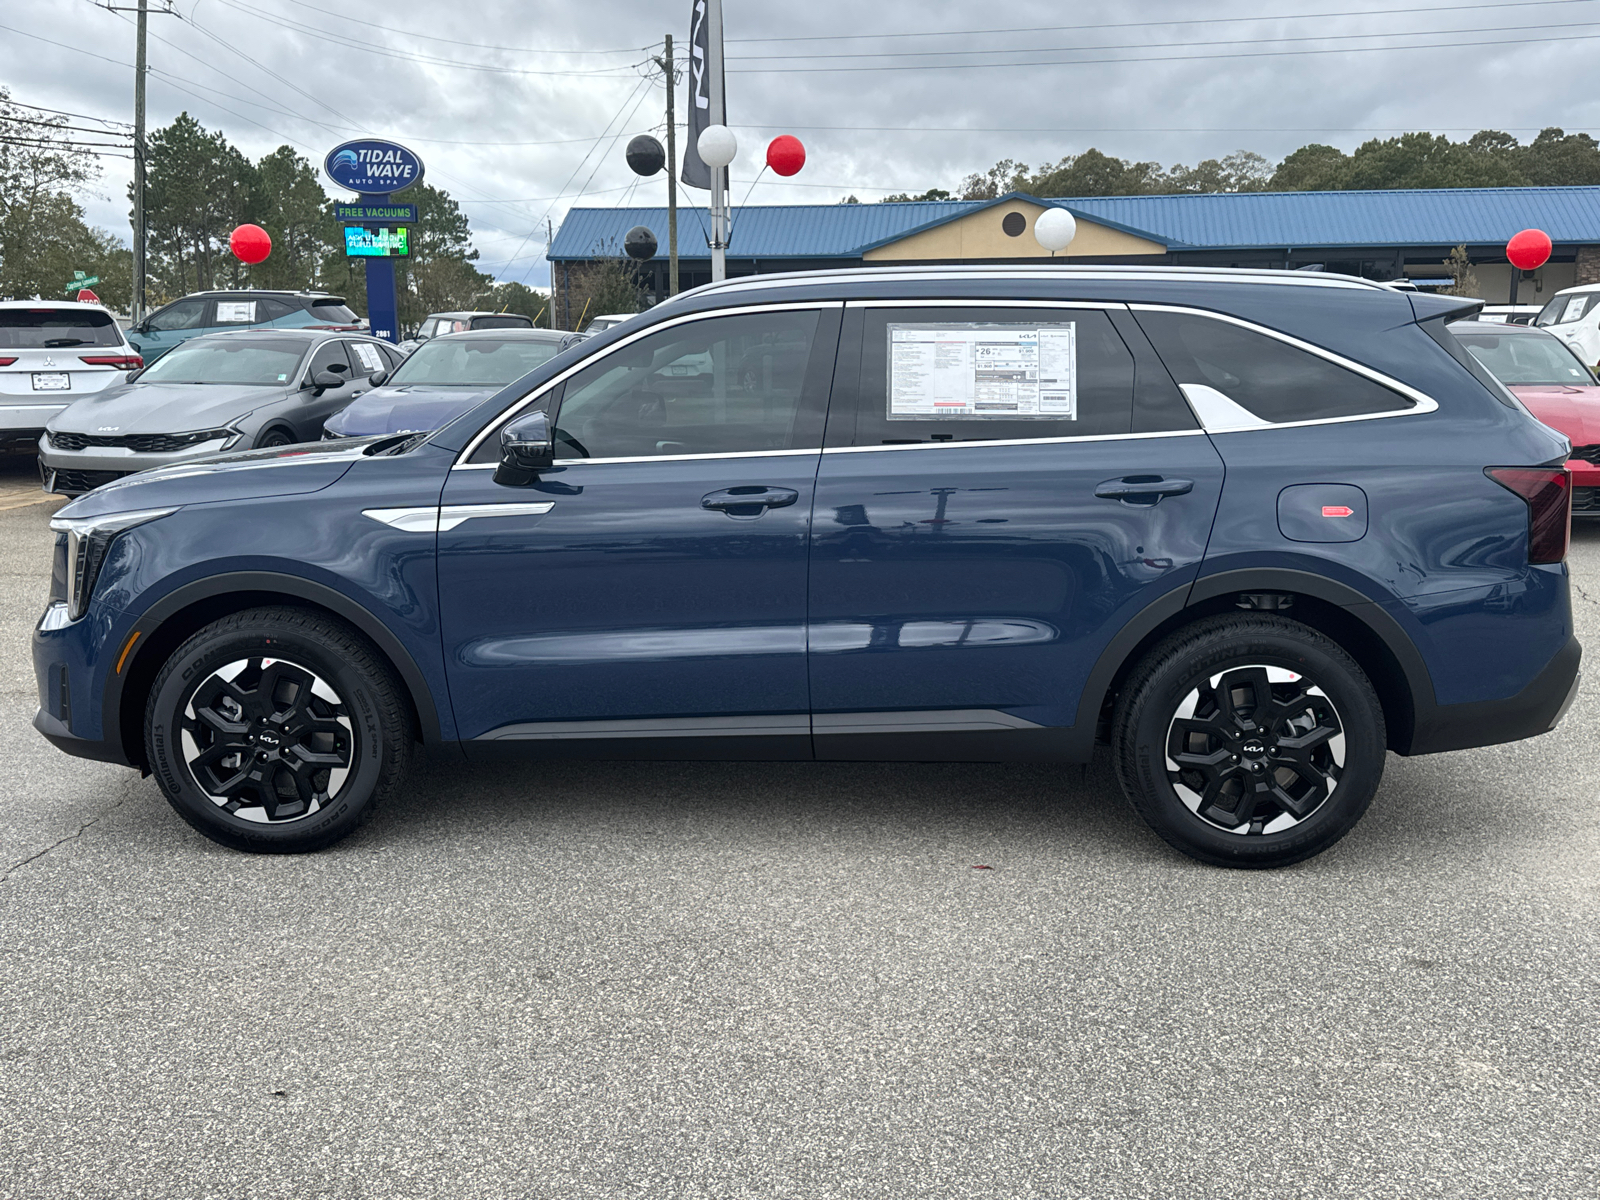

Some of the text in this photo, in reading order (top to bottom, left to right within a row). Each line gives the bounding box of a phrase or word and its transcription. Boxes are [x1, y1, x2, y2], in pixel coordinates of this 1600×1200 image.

[359, 149, 403, 163] TIDAL
[366, 164, 412, 178] WAVE
[339, 207, 411, 218] FREE VACUUMS
[980, 347, 991, 355] 26
[1243, 745, 1264, 753] KIA
